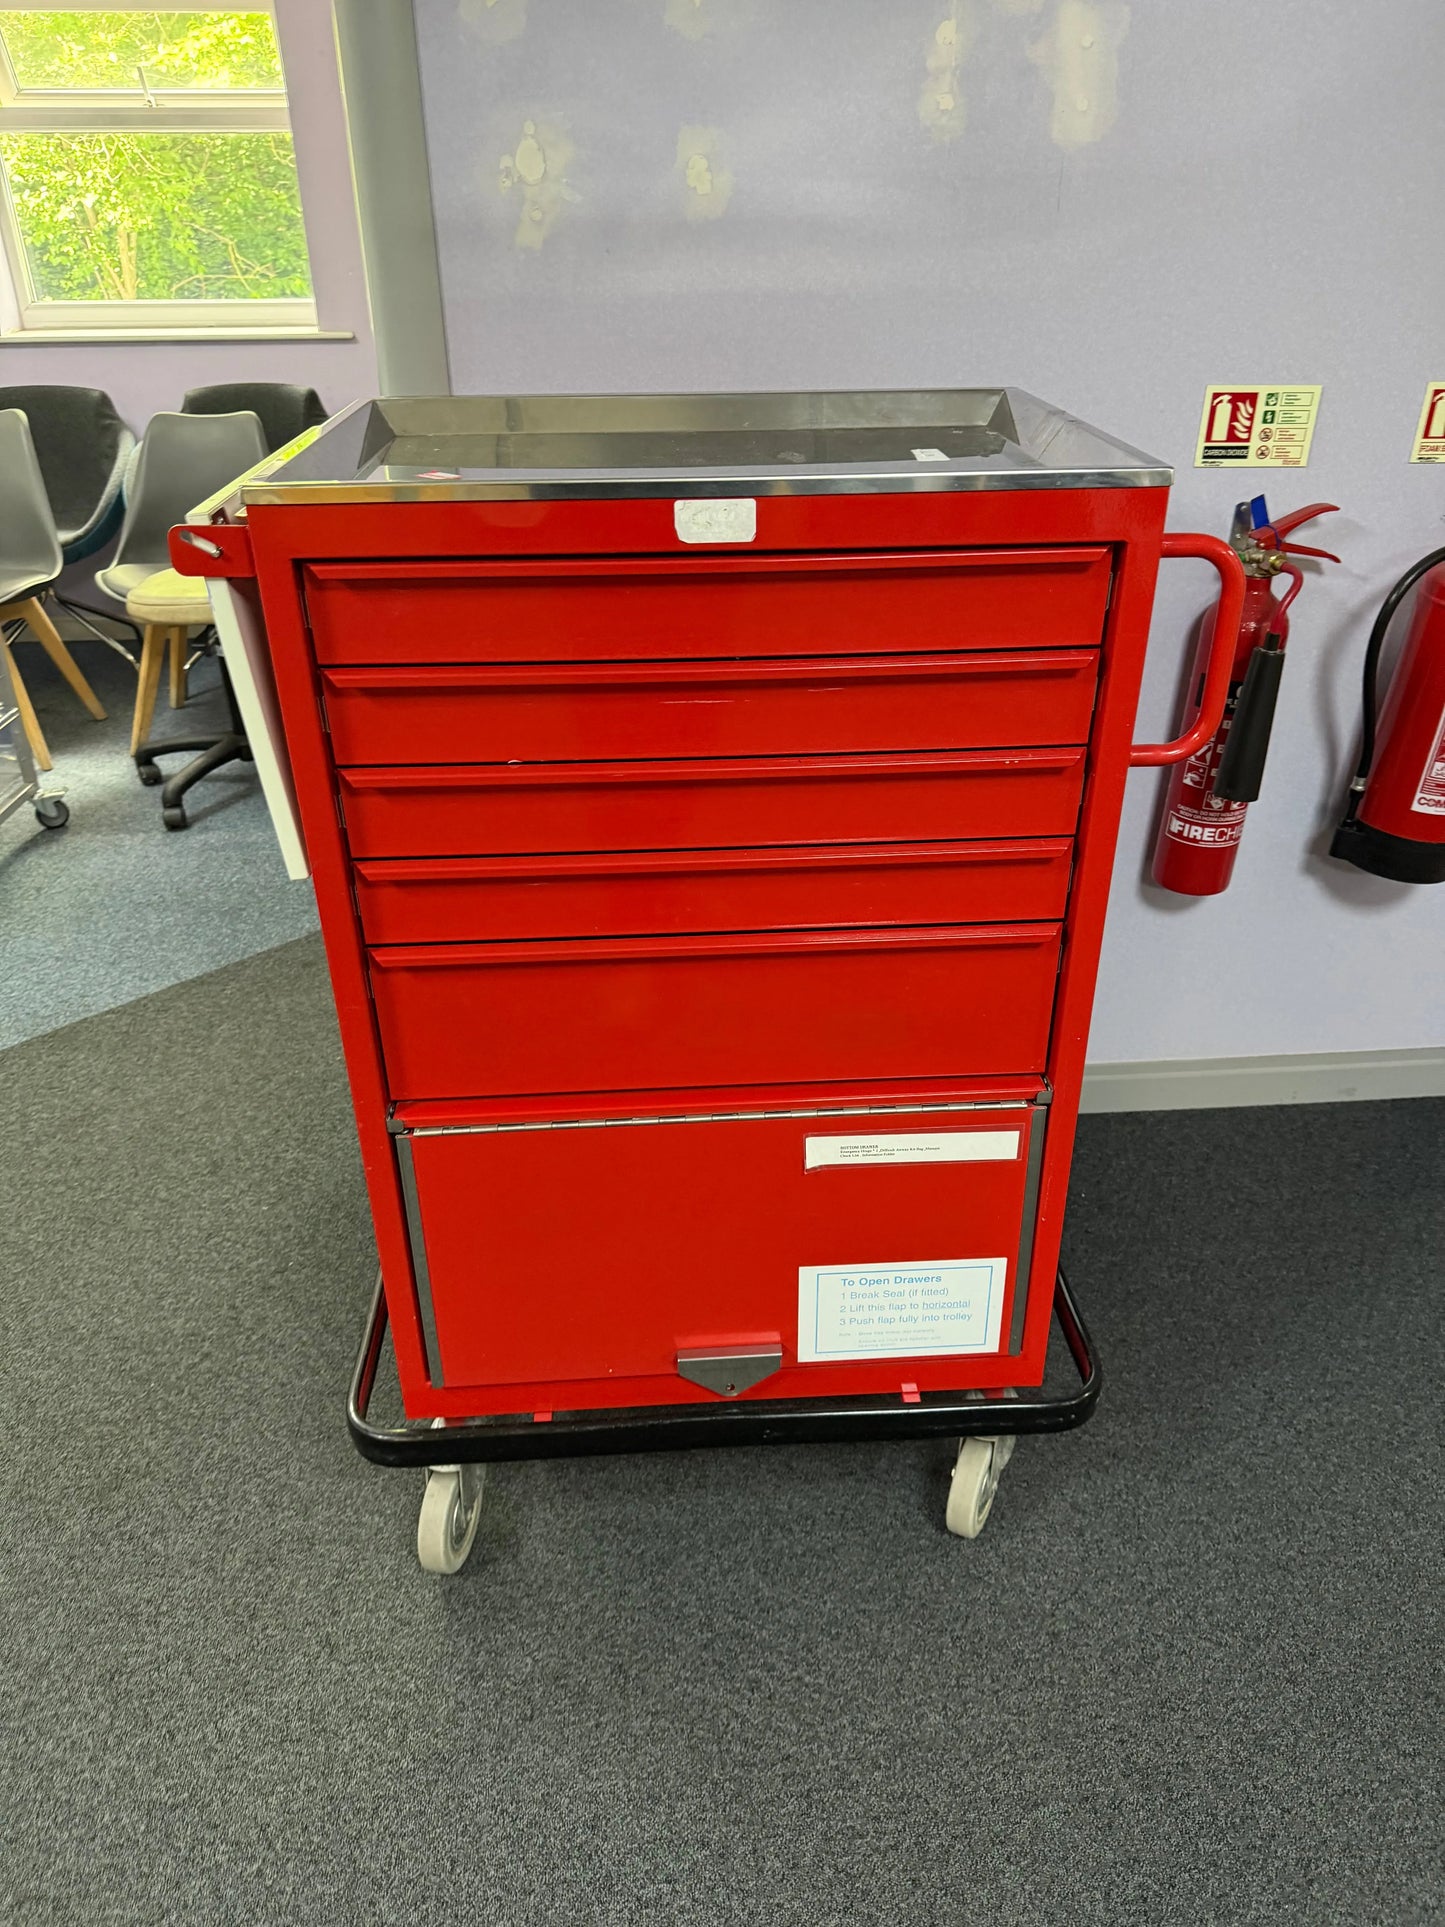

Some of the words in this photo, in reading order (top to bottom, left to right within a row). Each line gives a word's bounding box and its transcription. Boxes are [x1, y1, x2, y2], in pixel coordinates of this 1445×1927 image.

[841, 1278, 855, 1287] To
[859, 1276, 890, 1288] Open
[894, 1275, 942, 1285] Drawers
[841, 1292, 846, 1300] 1
[850, 1290, 880, 1300] Break
[883, 1289, 906, 1298] Seal
[908, 1289, 919, 1299] (if
[921, 1287, 950, 1297] fitted)
[840, 1305, 847, 1313] 2
[850, 1303, 865, 1313] Lift
[867, 1303, 886, 1312] this
[889, 1301, 908, 1313] flap
[910, 1302, 920, 1310] to
[922, 1299, 971, 1310] horizontal
[840, 1318, 847, 1326] 3
[850, 1316, 875, 1325] Push
[878, 1314, 896, 1325] flap
[899, 1313, 919, 1325] fully
[922, 1313, 941, 1321] into
[943, 1311, 973, 1322] trolley
